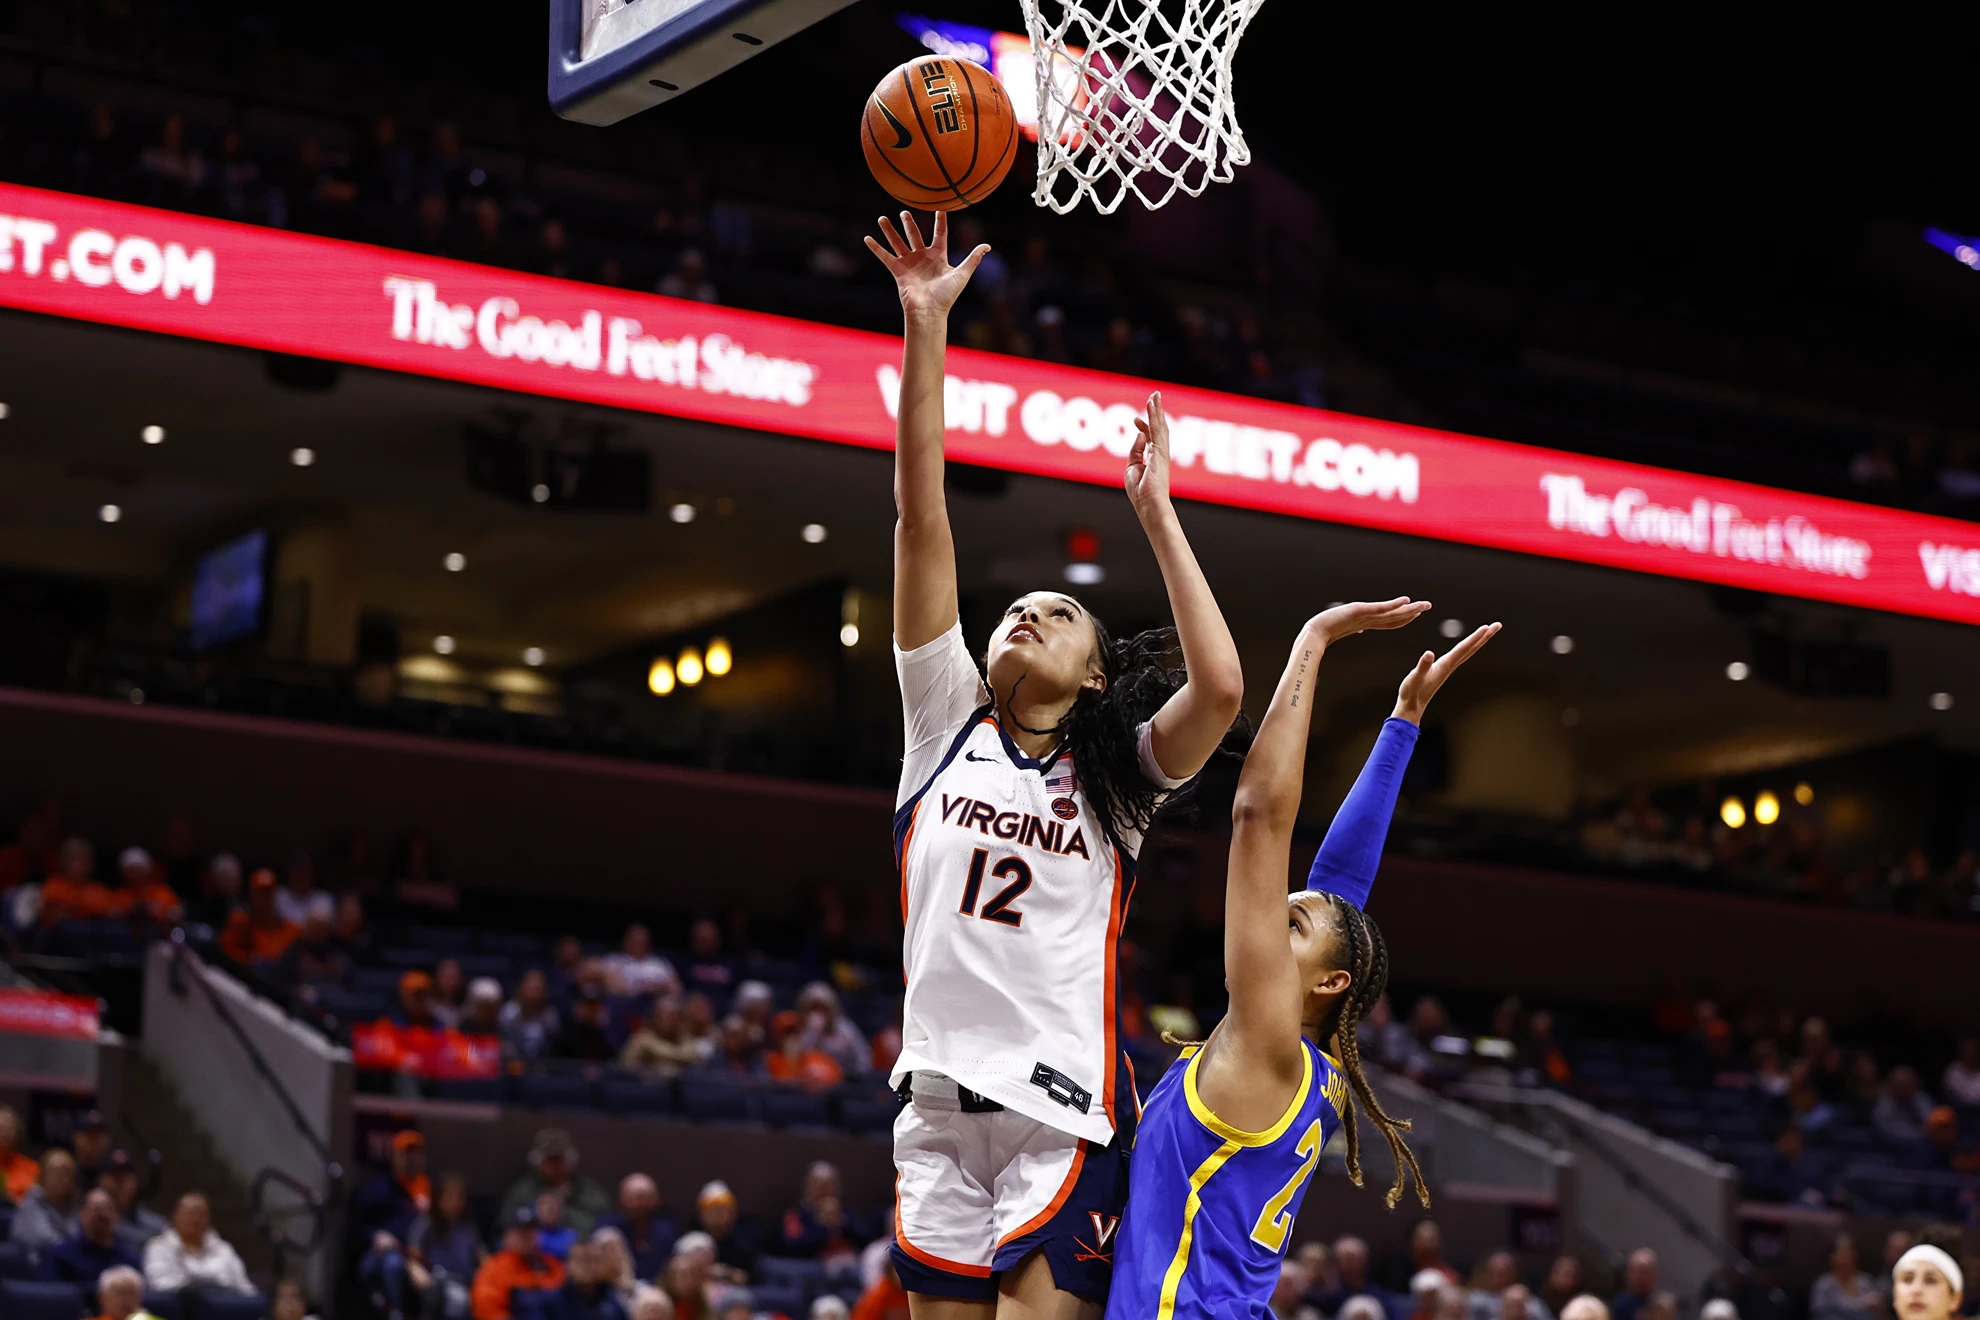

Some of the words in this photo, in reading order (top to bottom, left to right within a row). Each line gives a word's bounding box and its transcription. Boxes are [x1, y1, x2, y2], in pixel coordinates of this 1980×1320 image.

[919, 61, 961, 135] ELITE
[383, 275, 474, 350] The
[477, 296, 603, 381] Good
[607, 316, 699, 388] Feet
[700, 333, 821, 407] Store
[876, 364, 1018, 437] VSIT
[1539, 472, 1612, 538] The
[1612, 487, 1710, 553] Good
[1303, 650, 1312, 661] Let
[1291, 695, 1299, 707] God
[942, 793, 1091, 861] VIRGINIA
[959, 848, 1033, 927] 12
[1074, 1092, 1084, 1103] 46
